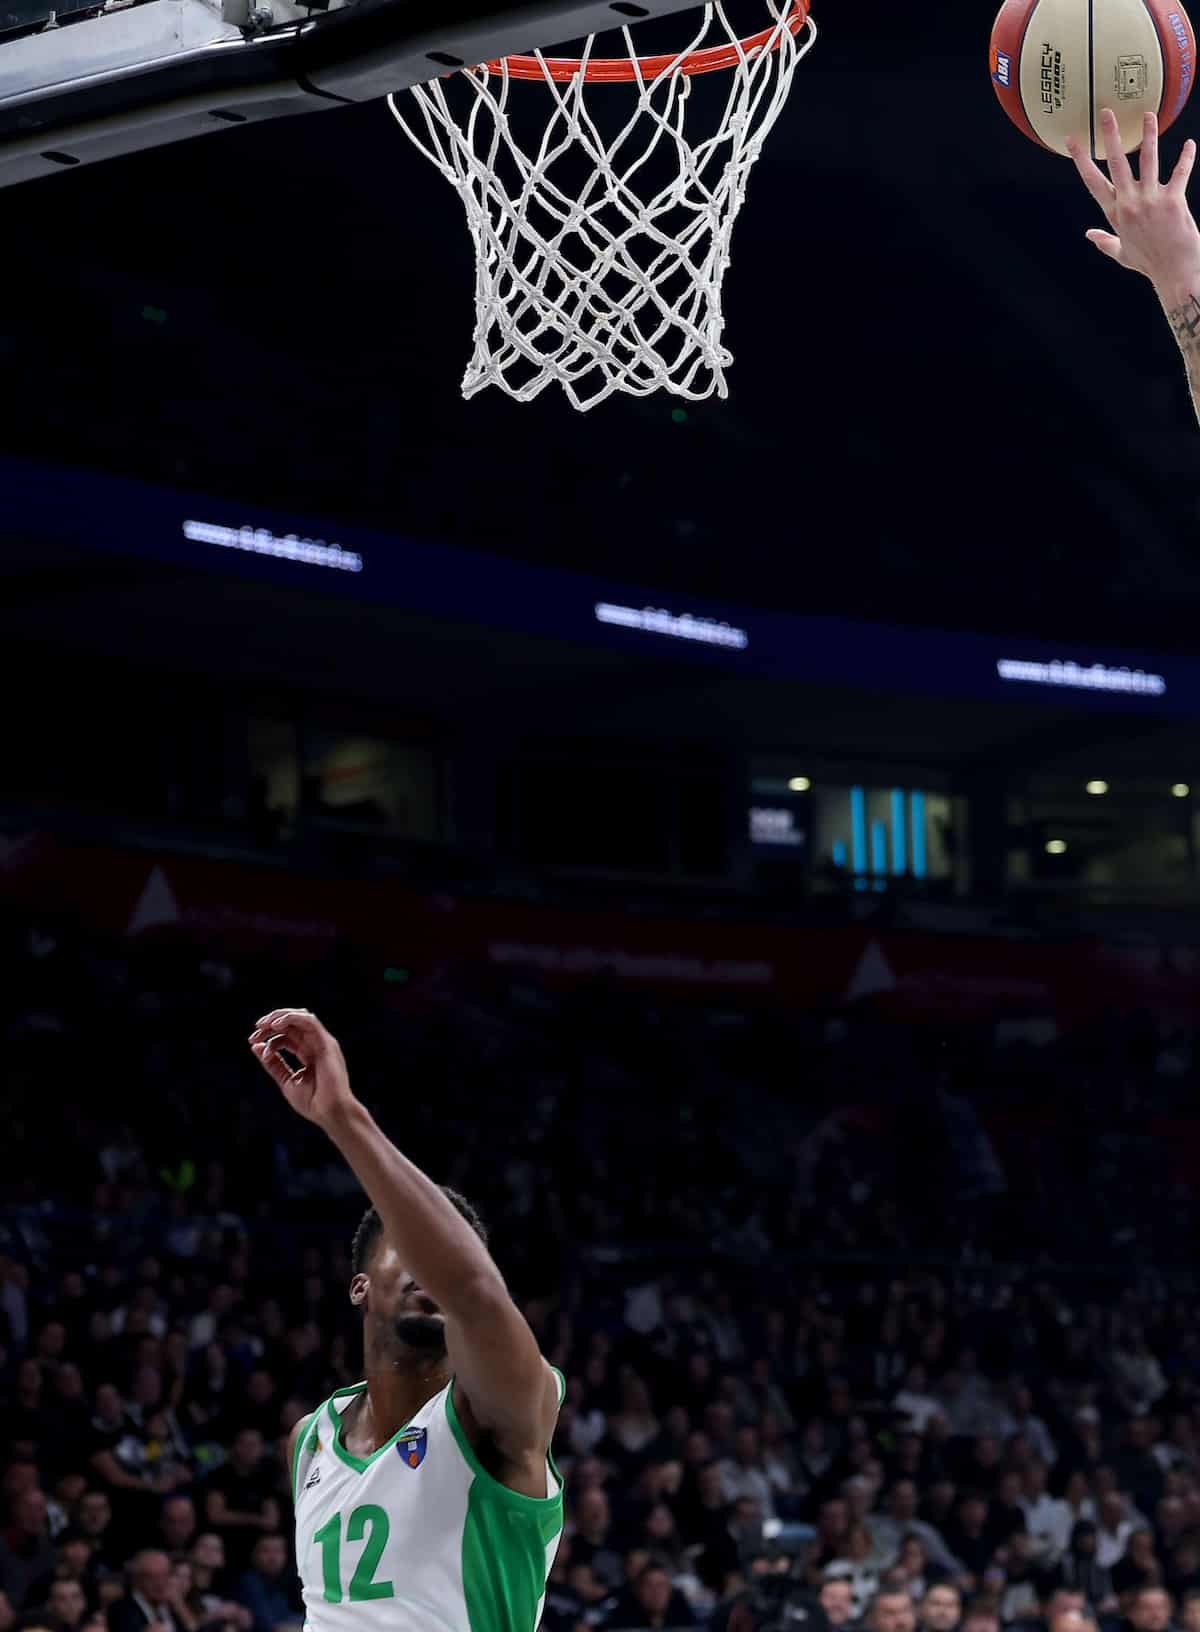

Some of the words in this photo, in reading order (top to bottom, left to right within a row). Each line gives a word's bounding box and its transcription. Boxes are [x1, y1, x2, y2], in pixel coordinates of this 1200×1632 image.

[997, 57, 1009, 86] ABA
[1040, 43, 1054, 114] LEGACY
[313, 1503, 394, 1603] 12
